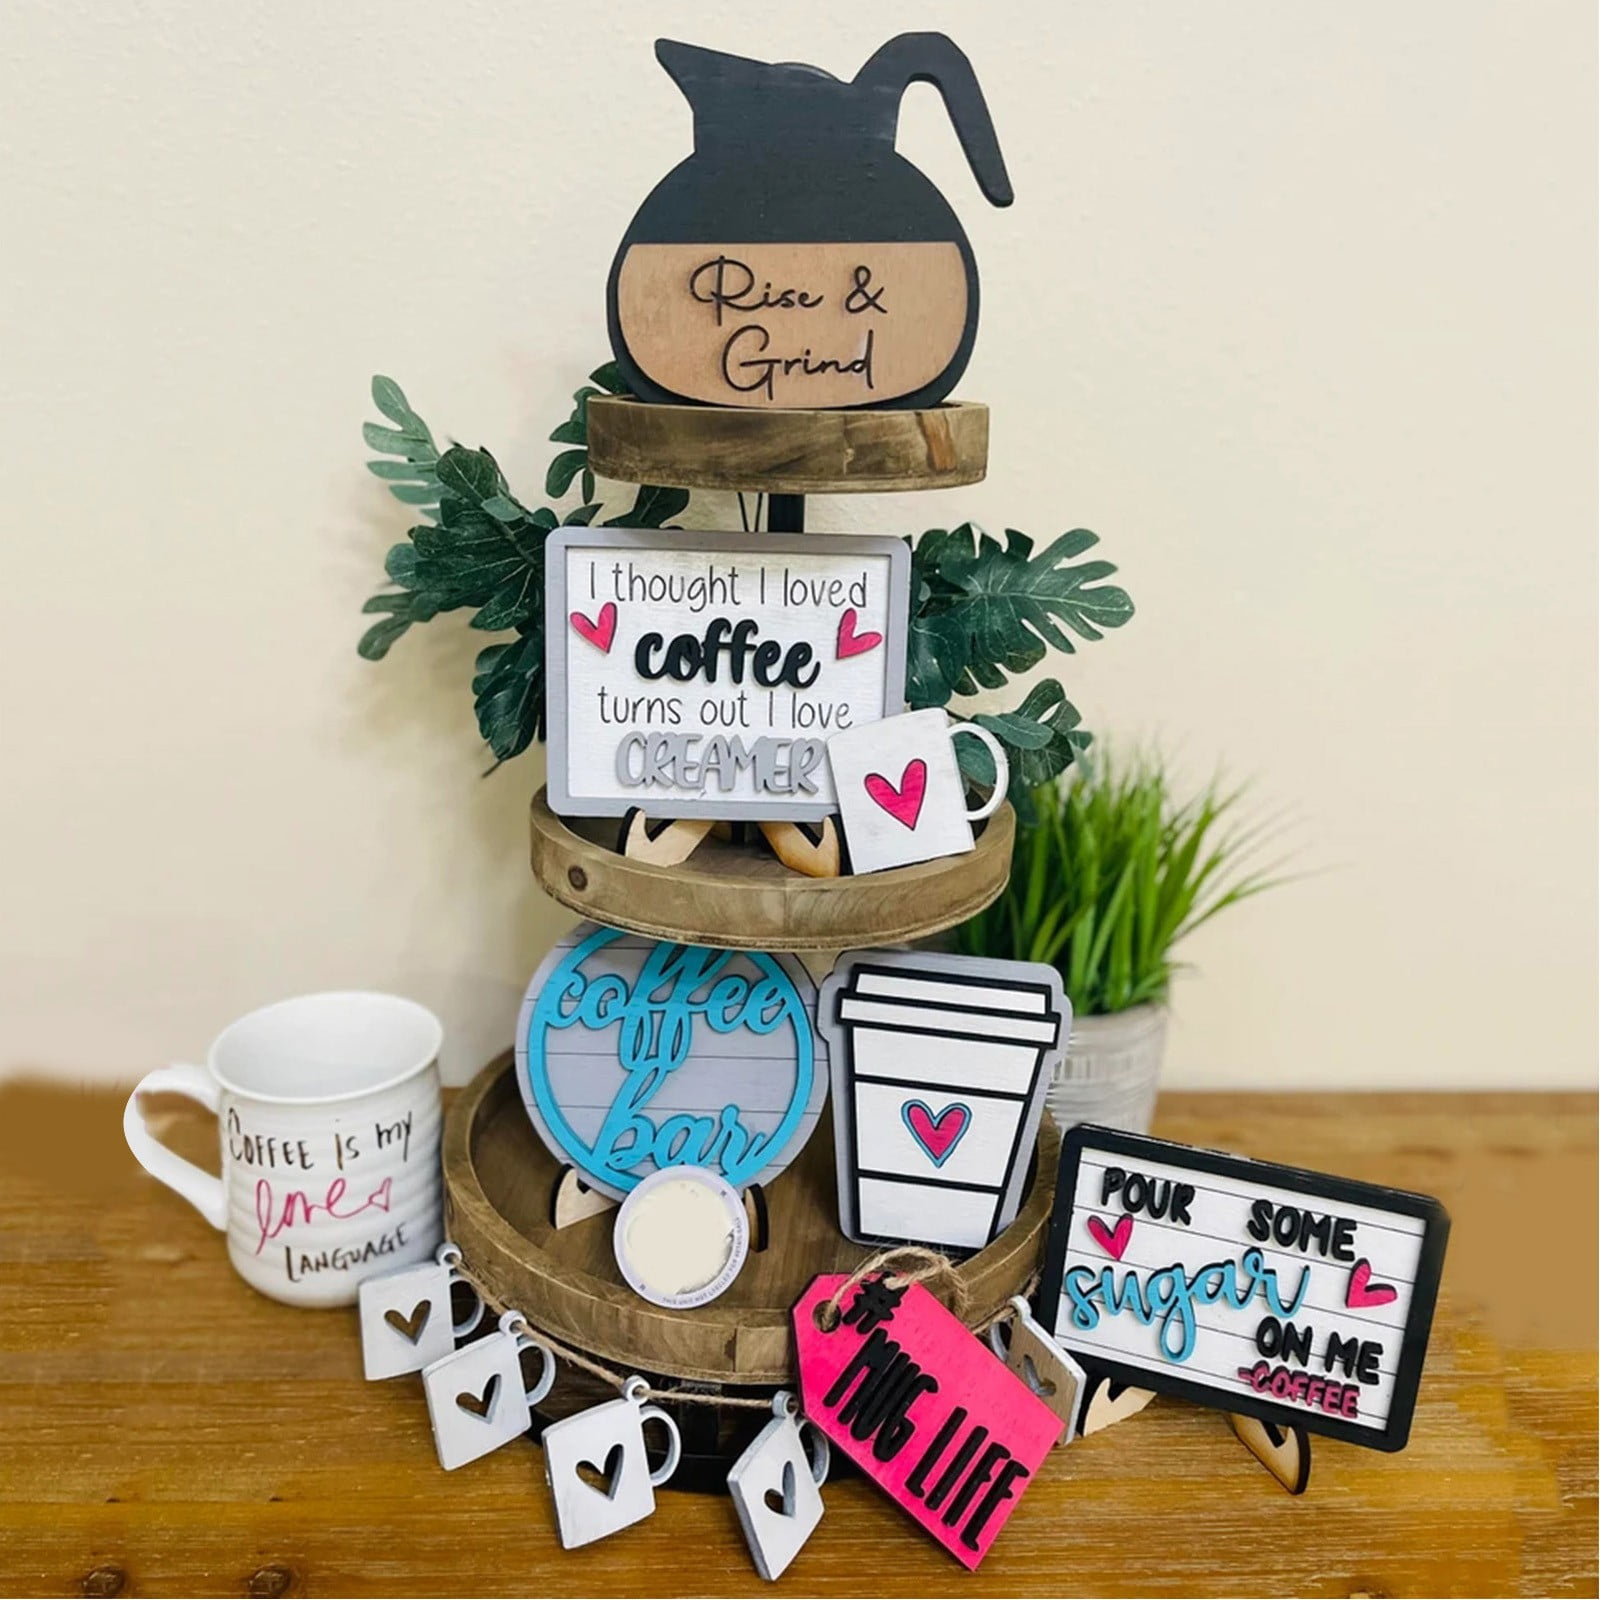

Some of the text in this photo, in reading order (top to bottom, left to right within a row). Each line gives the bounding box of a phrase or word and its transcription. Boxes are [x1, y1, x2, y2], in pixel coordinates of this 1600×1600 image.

[690, 255, 888, 327] Rise &
[722, 324, 875, 401] Grind
[589, 561, 868, 613] I thought I loved
[634, 617, 821, 689] coffee
[597, 686, 853, 730] turns out I love
[614, 730, 827, 794] CREAMER
[543, 942, 789, 1072] coffee
[593, 1066, 768, 1180] bar
[1101, 1166, 1358, 1261] POUR SOME
[1065, 1246, 1311, 1363] sugar
[1256, 1316, 1384, 1385] ON ME
[904, 1406, 1030, 1552] LIFE
